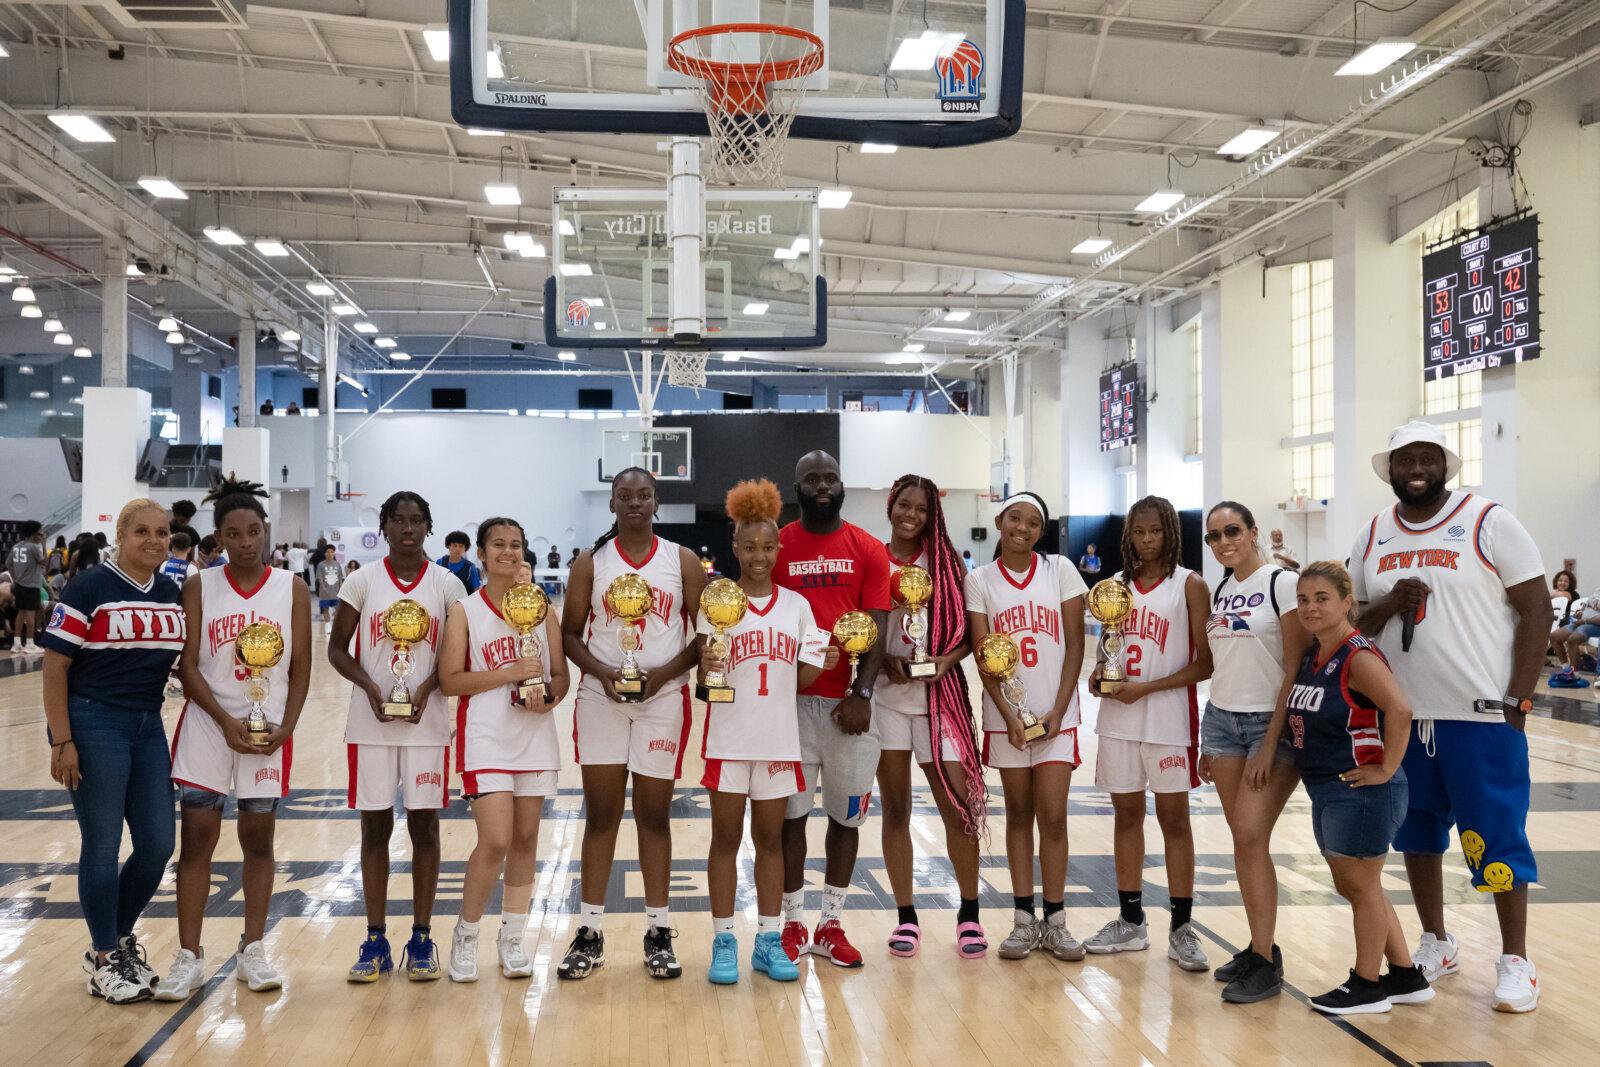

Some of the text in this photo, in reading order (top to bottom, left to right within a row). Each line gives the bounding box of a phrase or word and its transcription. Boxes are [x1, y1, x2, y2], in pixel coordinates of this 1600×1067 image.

[494, 92, 548, 106] SPALDING
[952, 102, 979, 111] NBPA
[1463, 238, 1488, 256] COURT #3
[1472, 270, 1478, 286] 0
[1504, 267, 1521, 292] 42
[1435, 290, 1449, 314] 53
[1473, 290, 1491, 315] 0.0
[1473, 335, 1479, 350] 2
[13, 547, 28, 563] 35
[1376, 548, 1460, 575] NEW YORK
[788, 560, 854, 577] BASKETBALL
[802, 573, 841, 587] CITY
[208, 613, 246, 657] MEYER
[993, 600, 1060, 645] MEYER LEVIN
[1139, 605, 1170, 655] LEVIN
[481, 636, 517, 671] MEYER
[727, 630, 765, 674] MEYER
[1020, 636, 1039, 668] 6
[1126, 644, 1143, 676] 2
[757, 663, 769, 696] 1
